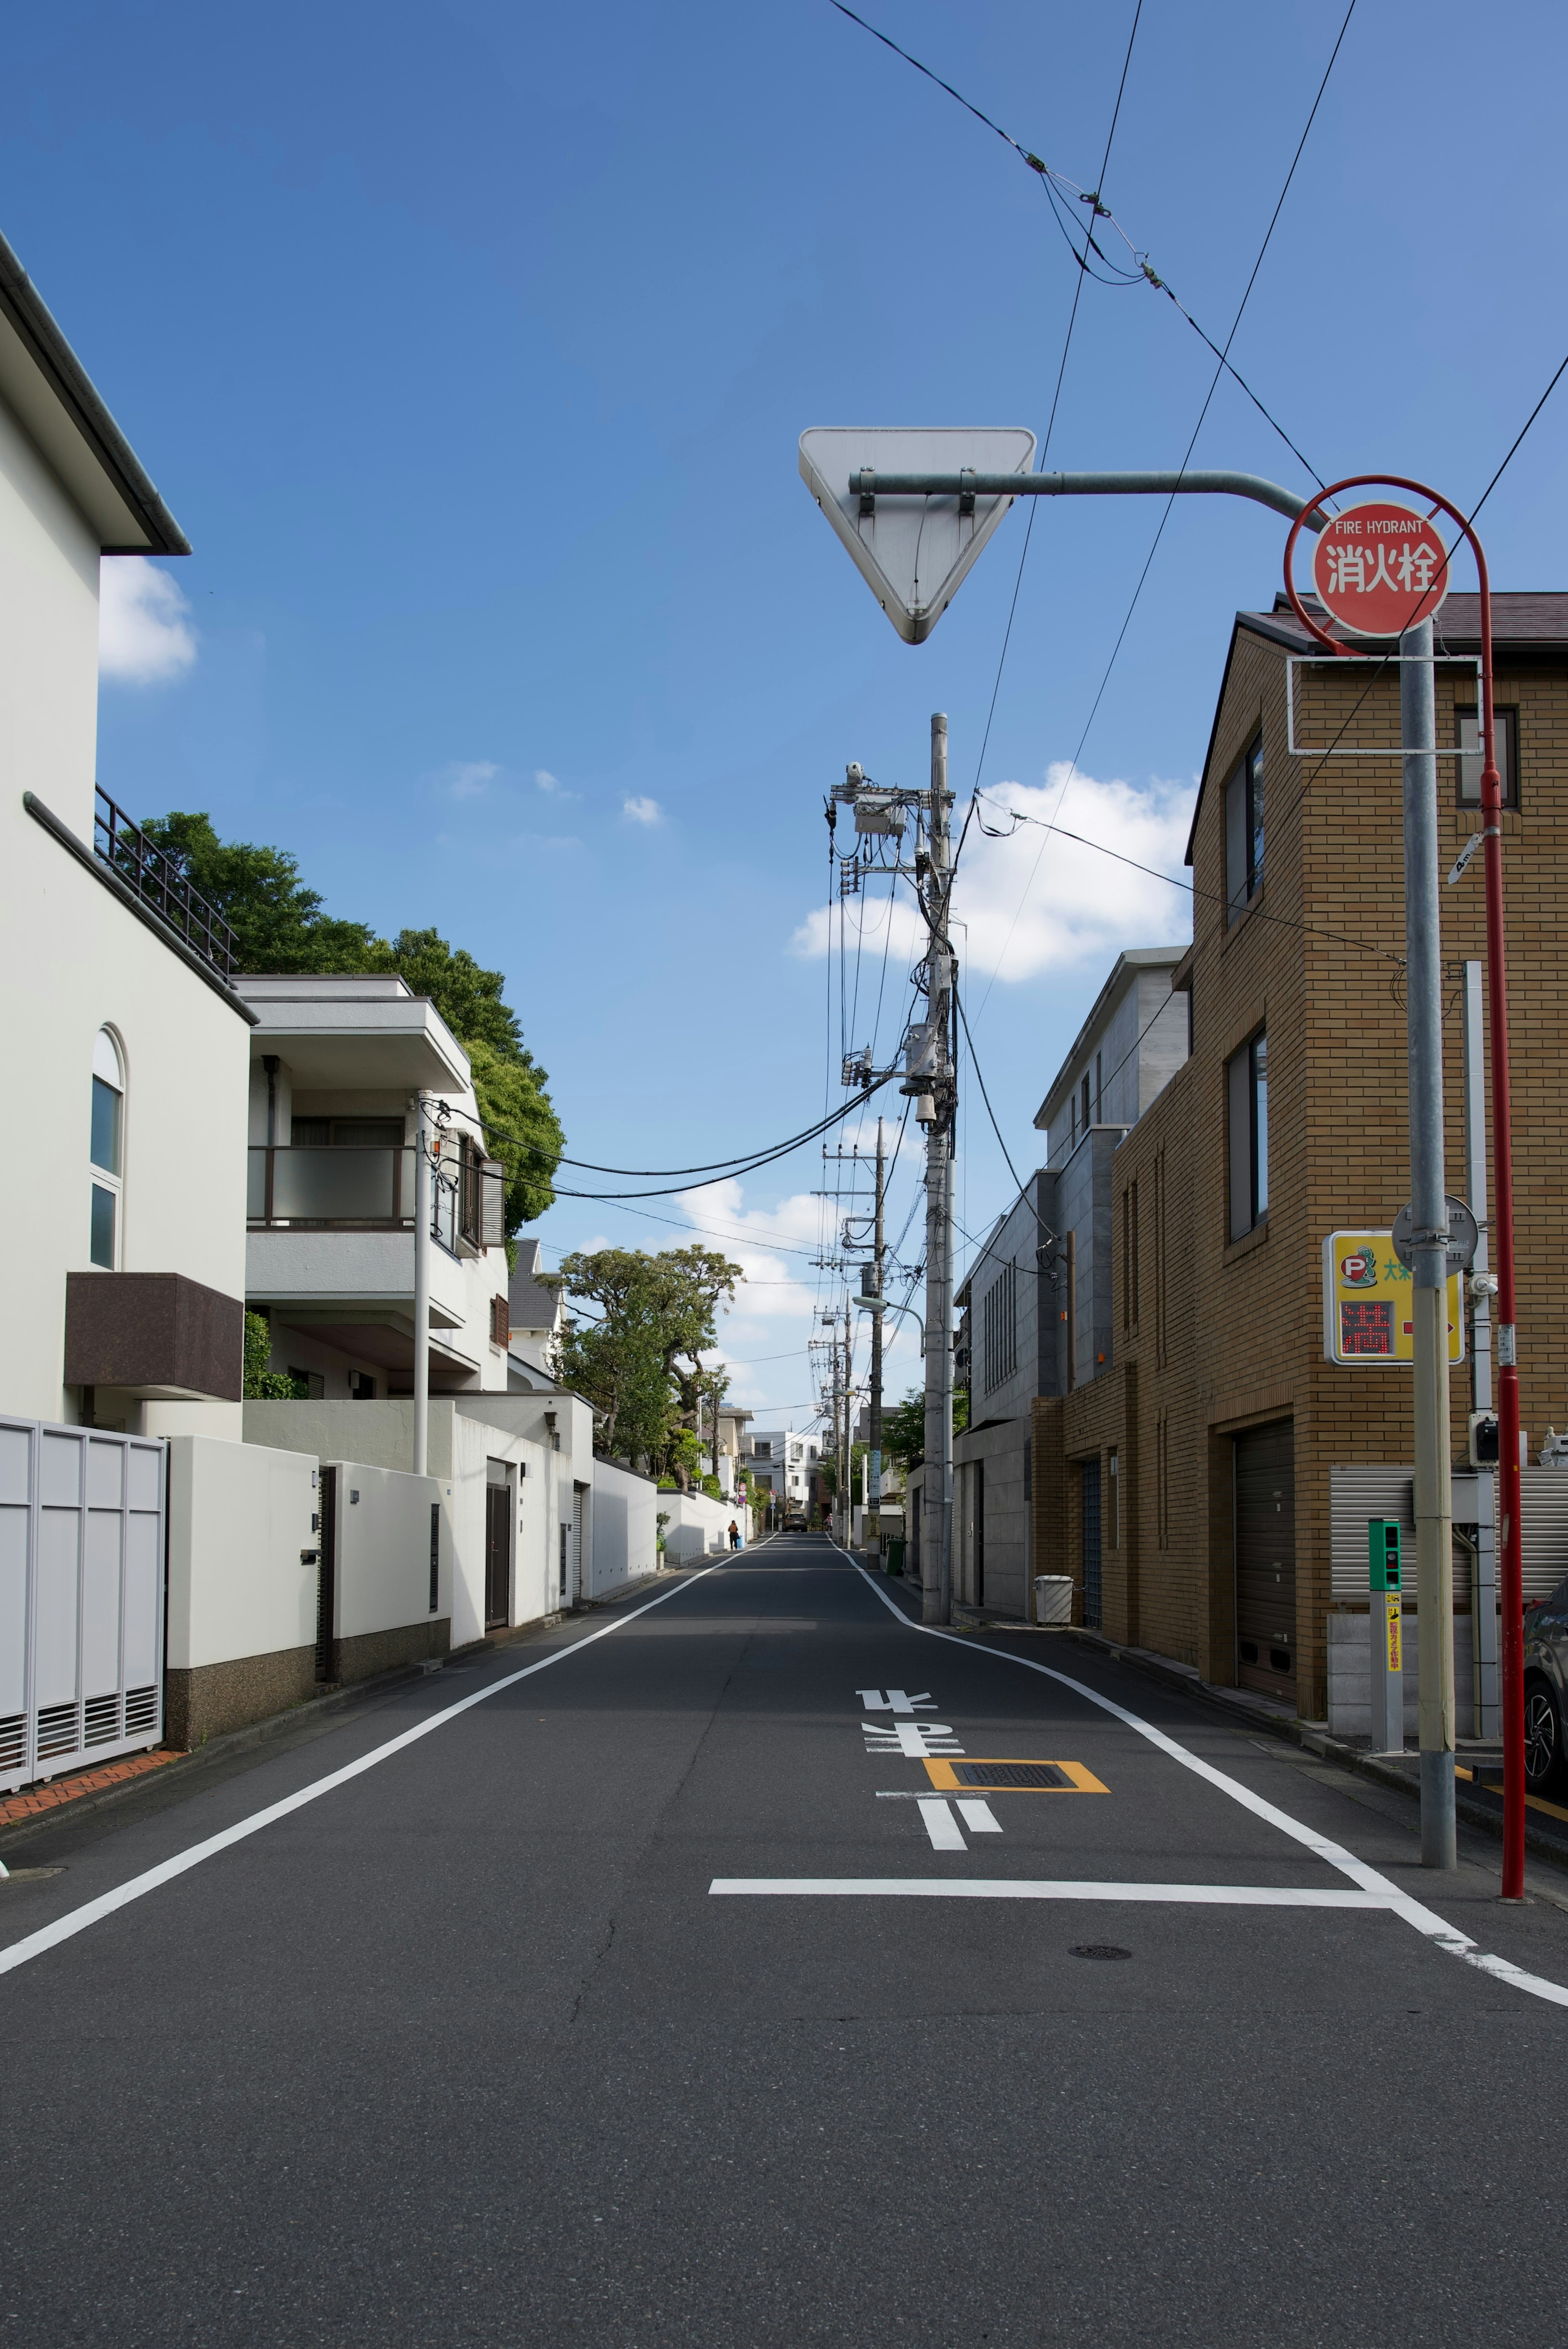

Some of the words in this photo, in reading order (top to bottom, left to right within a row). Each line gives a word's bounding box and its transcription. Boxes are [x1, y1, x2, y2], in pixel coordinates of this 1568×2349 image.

[1336, 521, 1362, 534] FIRE
[1367, 520, 1423, 534] HYDRANT
[1326, 542, 1438, 593] 消火栓
[1345, 1258, 1365, 1276] P
[1342, 1305, 1390, 1353] 満
[856, 1690, 1003, 1850] 止まれ
